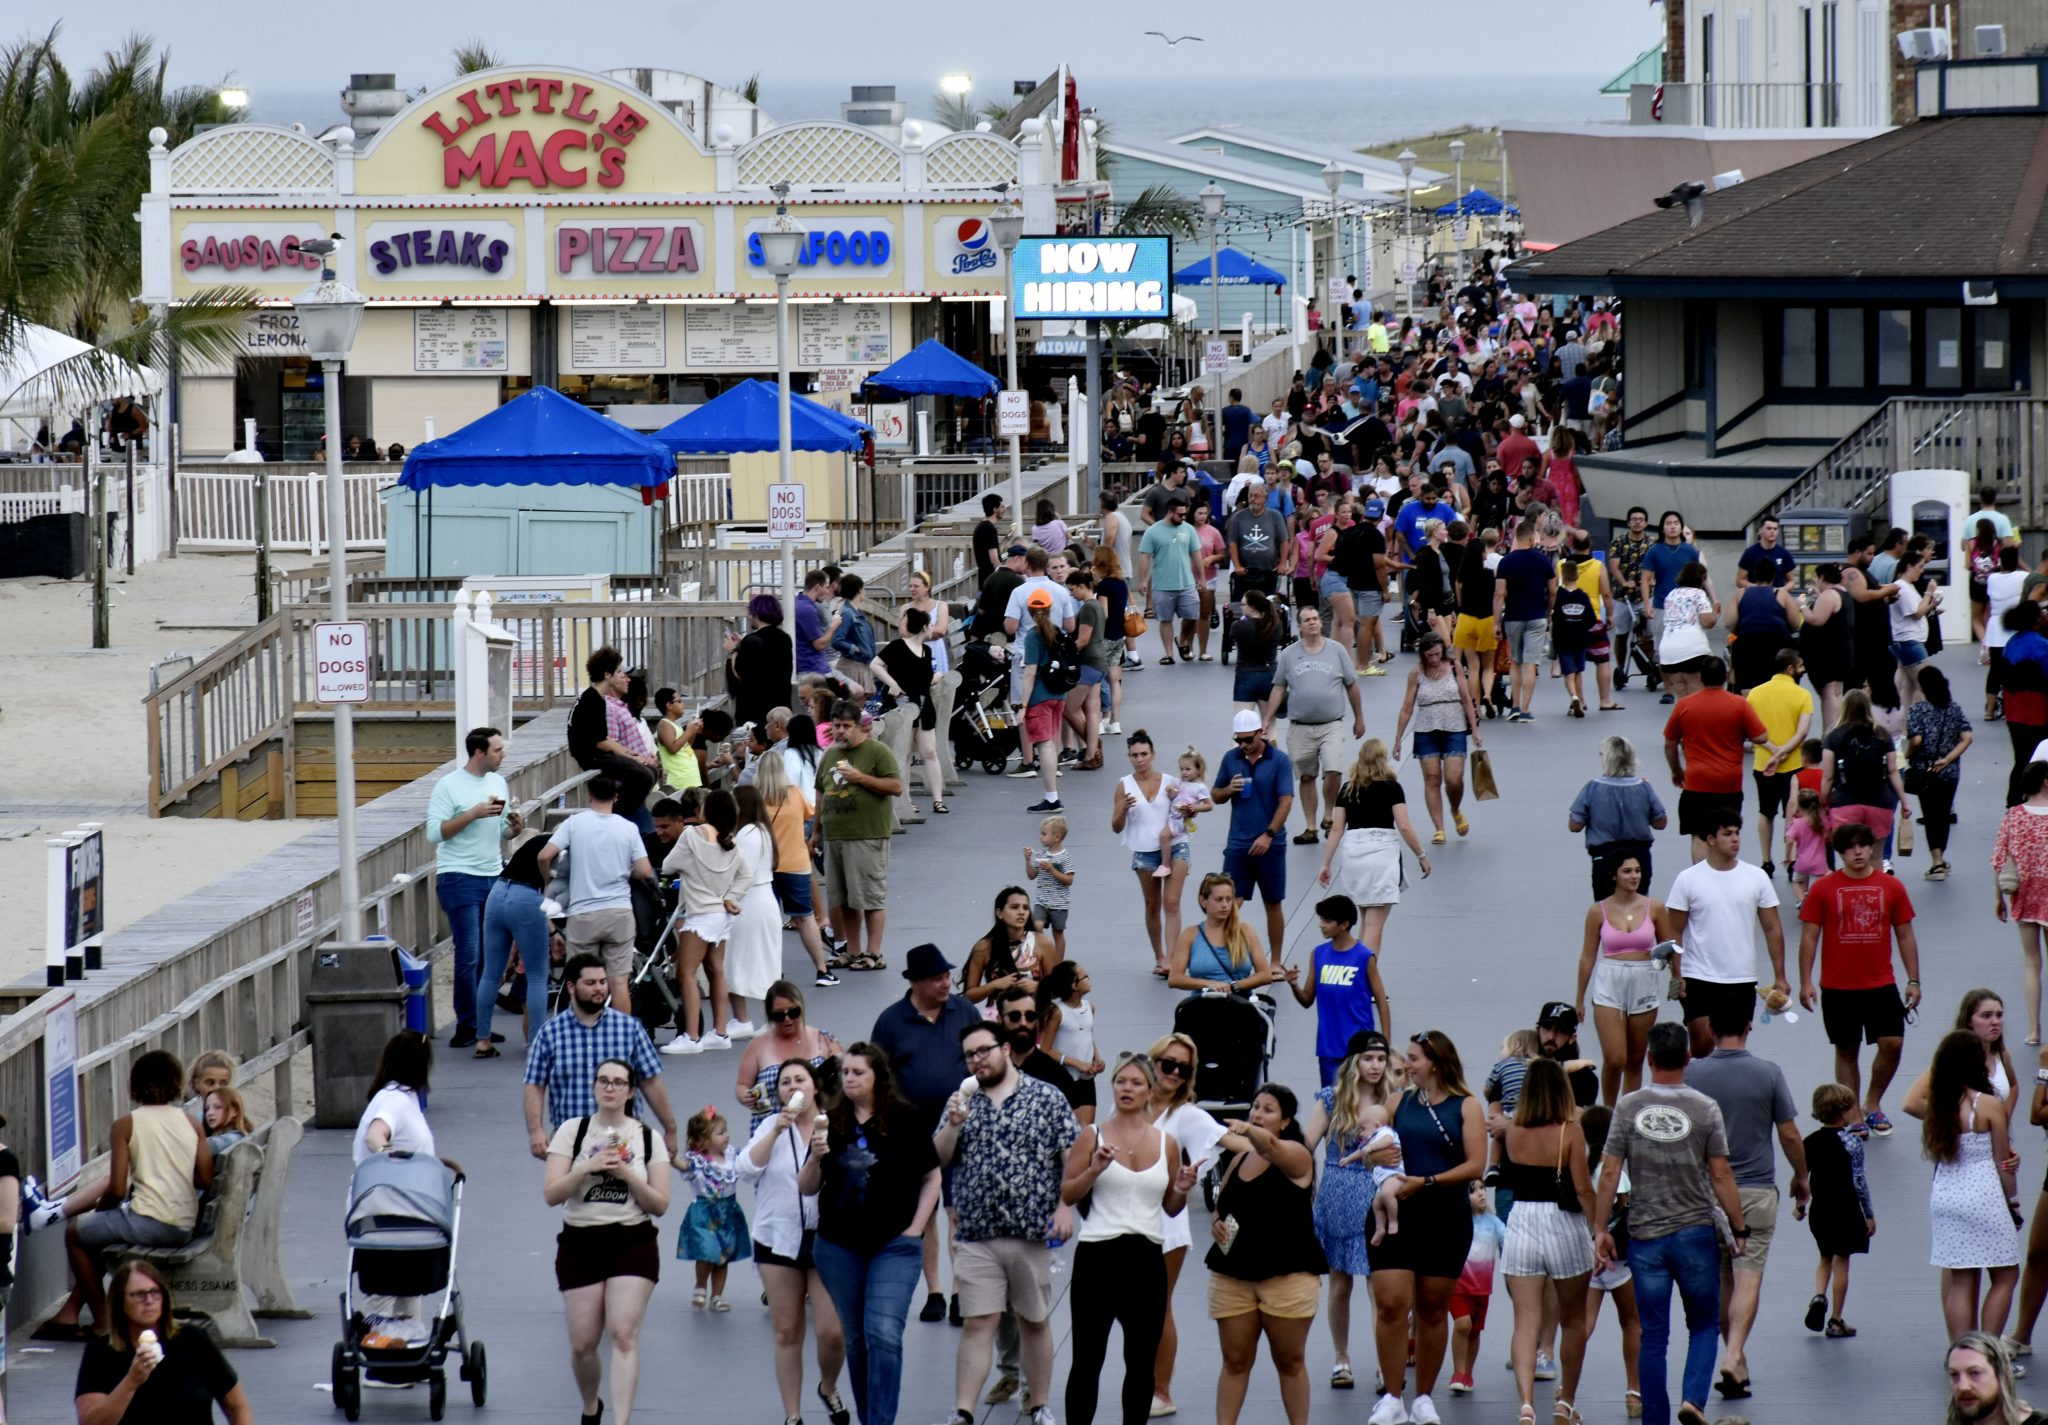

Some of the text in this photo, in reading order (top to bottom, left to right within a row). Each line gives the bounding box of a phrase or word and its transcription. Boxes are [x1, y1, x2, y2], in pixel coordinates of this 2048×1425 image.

[421, 77, 649, 148] LITTLE
[443, 129, 627, 188] MAC'S
[369, 230, 509, 274] STEAKS
[558, 226, 699, 273] PIZZA
[748, 230, 891, 267] SAFOOD
[1040, 242, 1137, 274] NOW
[1024, 280, 1164, 312] HIRING
[259, 314, 300, 329] FROZ
[248, 332, 306, 347] LEMON
[1016, 328, 1031, 338] ATM
[1034, 340, 1087, 354] MIDWA
[1007, 396, 1020, 404] NO
[1001, 411, 1027, 419] DOGS
[777, 491, 796, 504] NO
[771, 506, 802, 519] DOGS
[771, 521, 803, 531] ALLOWED
[329, 633, 352, 646] NO
[319, 660, 365, 674] DOGS
[1319, 963, 1360, 986] NIKE
[589, 1186, 628, 1201] BLOOM
